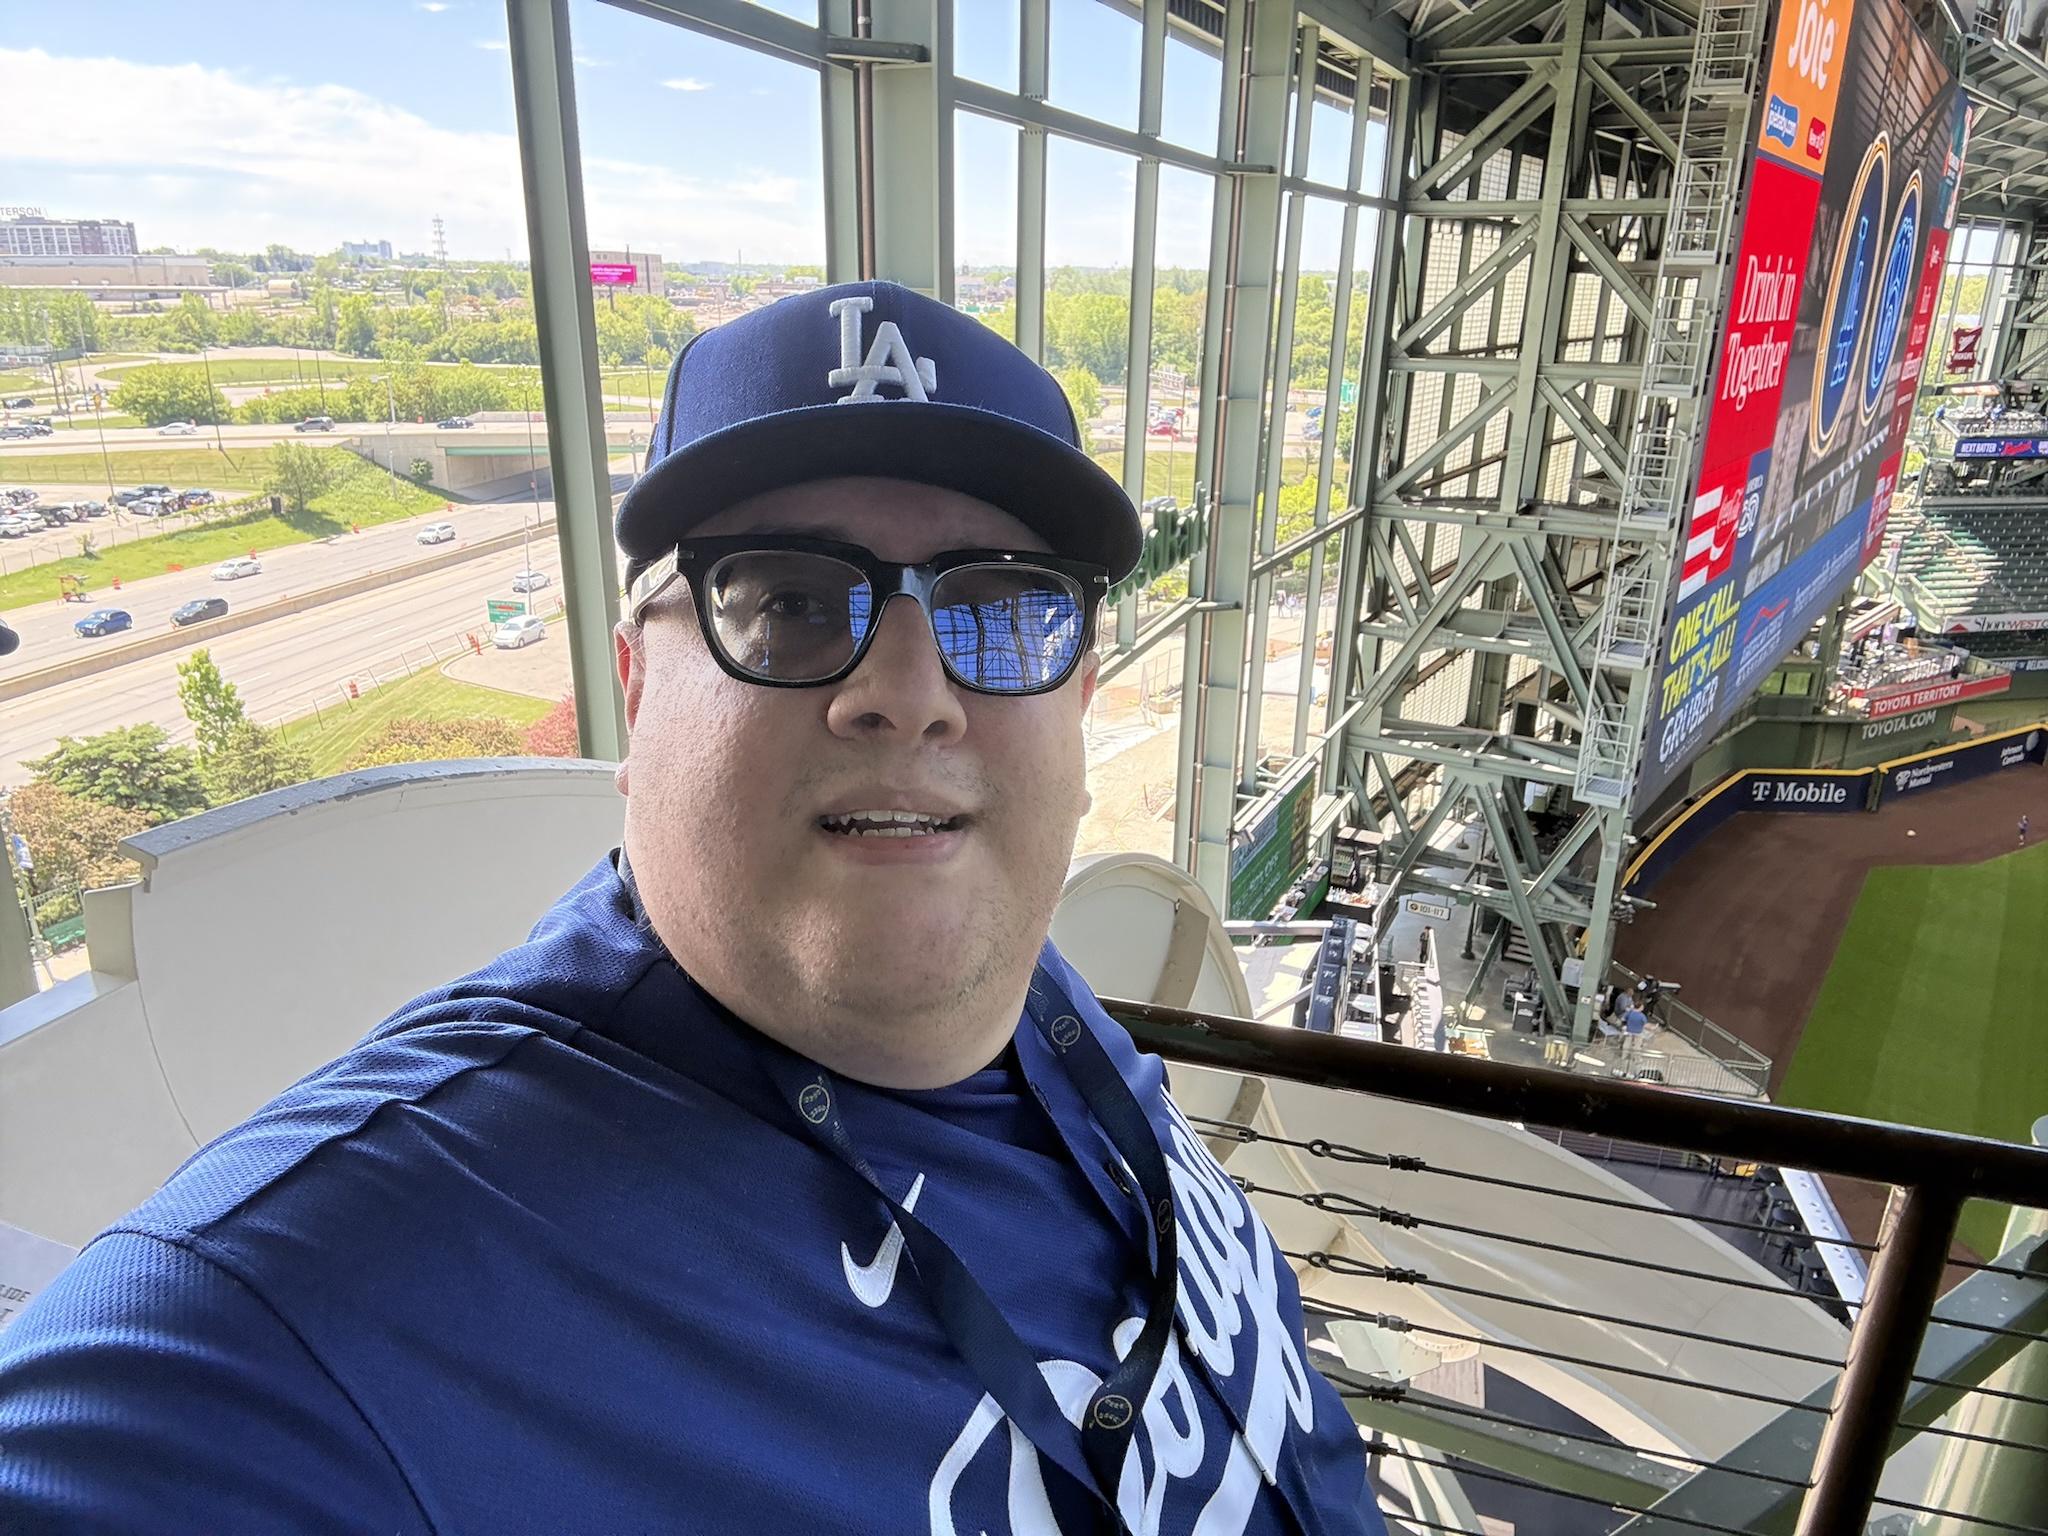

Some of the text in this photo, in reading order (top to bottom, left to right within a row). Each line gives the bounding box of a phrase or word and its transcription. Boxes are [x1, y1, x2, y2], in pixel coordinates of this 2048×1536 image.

[1788, 0, 1835, 90] Joie
[1738, 254, 1796, 324] Drink in
[828, 296, 938, 404] LA
[1722, 326, 1789, 411] Together
[1669, 602, 1706, 665] ONE
[1707, 620, 1737, 677] ALL!
[1659, 675, 1719, 763] GRUBER
[1862, 710, 1938, 740] TOYOTA.COM
[1874, 682, 1964, 714] TOYOTA TERRITORY
[1774, 780, 1847, 804] Mobile
